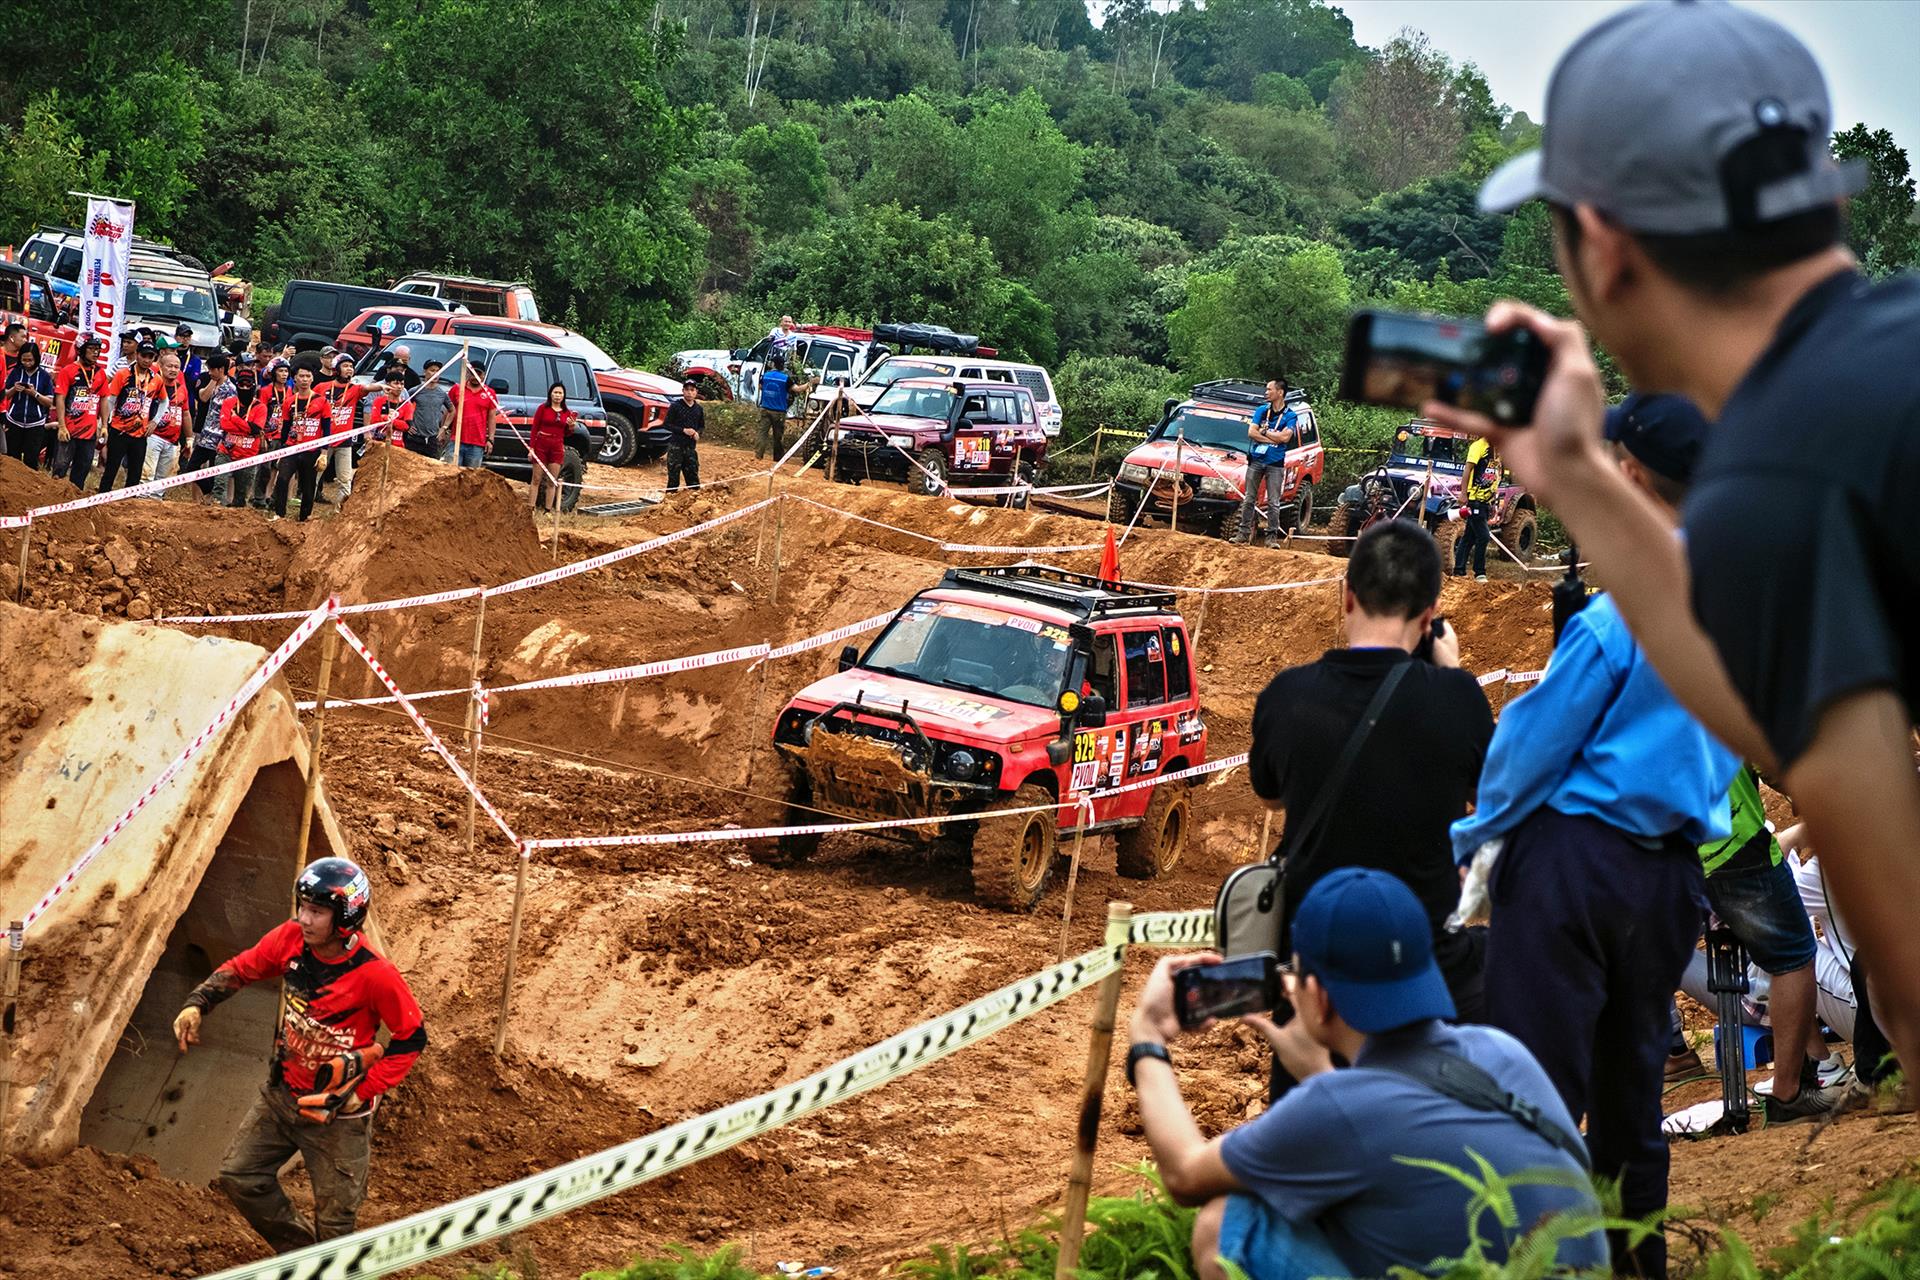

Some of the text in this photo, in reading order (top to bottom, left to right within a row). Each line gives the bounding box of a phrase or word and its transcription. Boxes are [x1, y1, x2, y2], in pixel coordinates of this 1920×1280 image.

[92, 258, 102, 298] PETROVIETNAM
[48, 339, 61, 355] 321
[1010, 617, 1070, 641] PVOIL 325
[1074, 733, 1096, 763] 325
[1072, 763, 1098, 789] PVOIL
